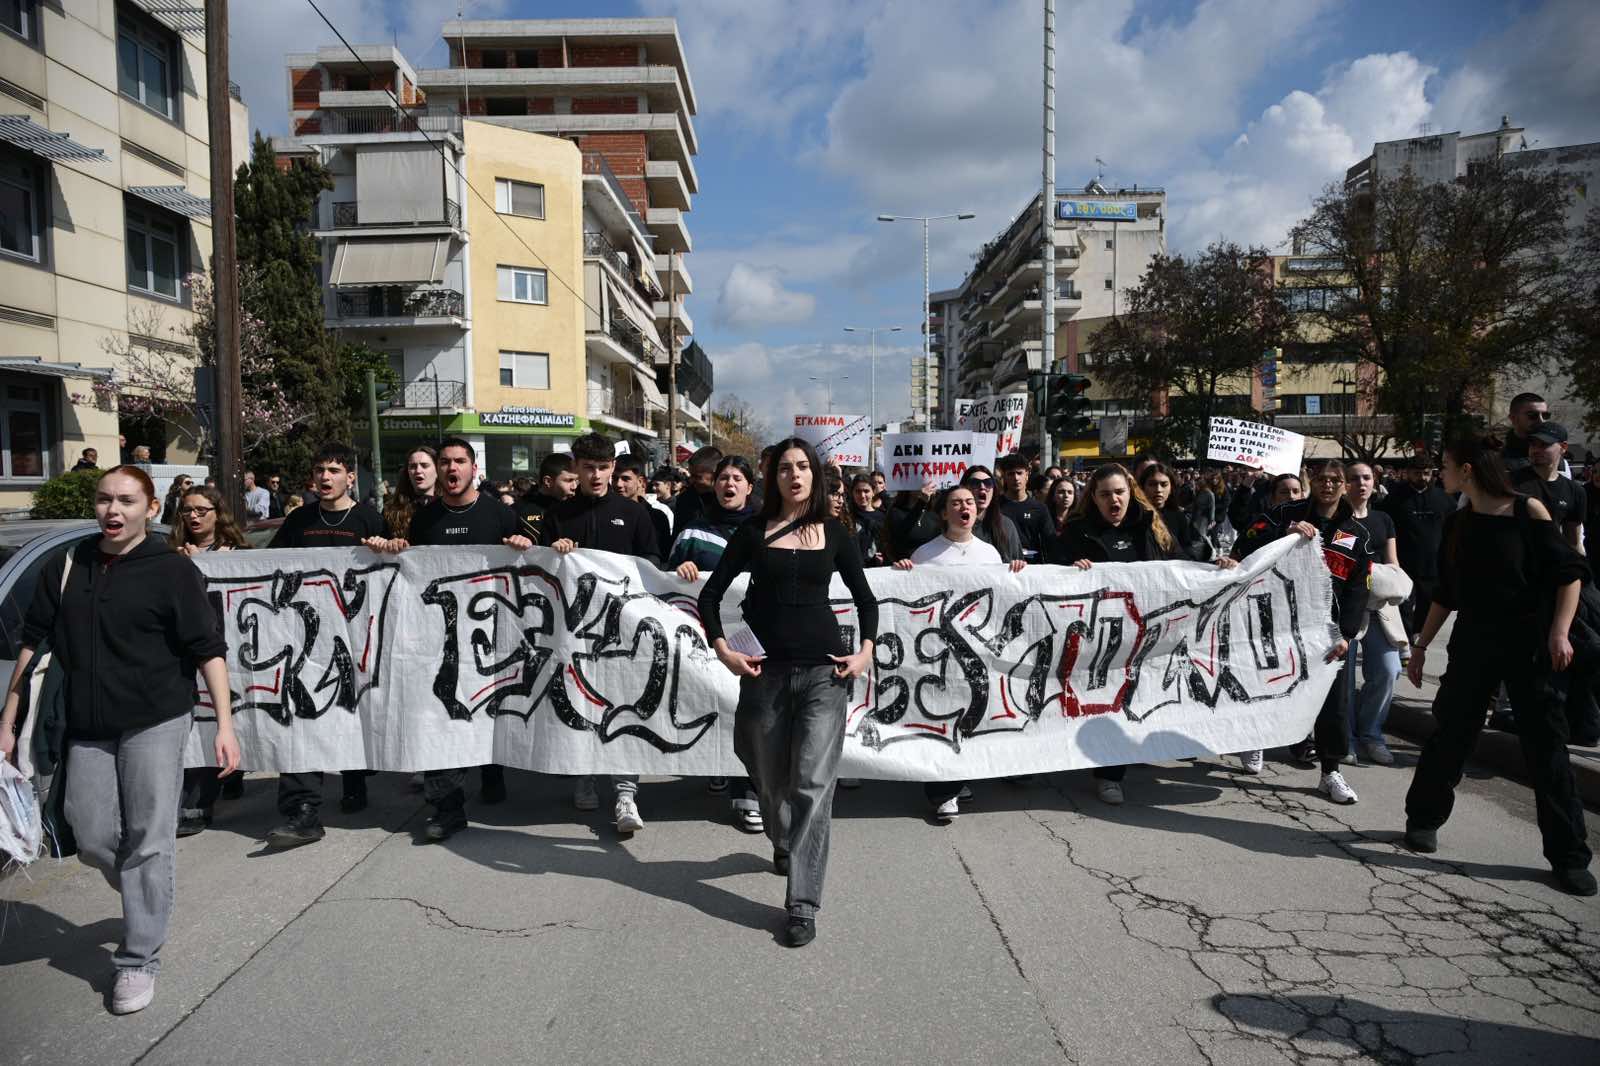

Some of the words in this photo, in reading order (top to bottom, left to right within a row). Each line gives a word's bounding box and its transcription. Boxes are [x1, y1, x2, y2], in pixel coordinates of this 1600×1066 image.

[993, 397, 1024, 412] ΛΕΦΤΑ
[483, 413, 574, 426] ΧΑΤΖΗΕΦΡΑΙΜΙΔΗΣ
[795, 416, 845, 426] ΕΓΚΛΗΜΑ
[1214, 418, 1234, 426] ΝΑ
[893, 444, 923, 456] ΔΕΝ
[932, 444, 972, 455] ΗΤΑΝ
[892, 461, 968, 480] ΑΤΥΧΗΜΑ
[194, 562, 401, 727] ΕΝ
